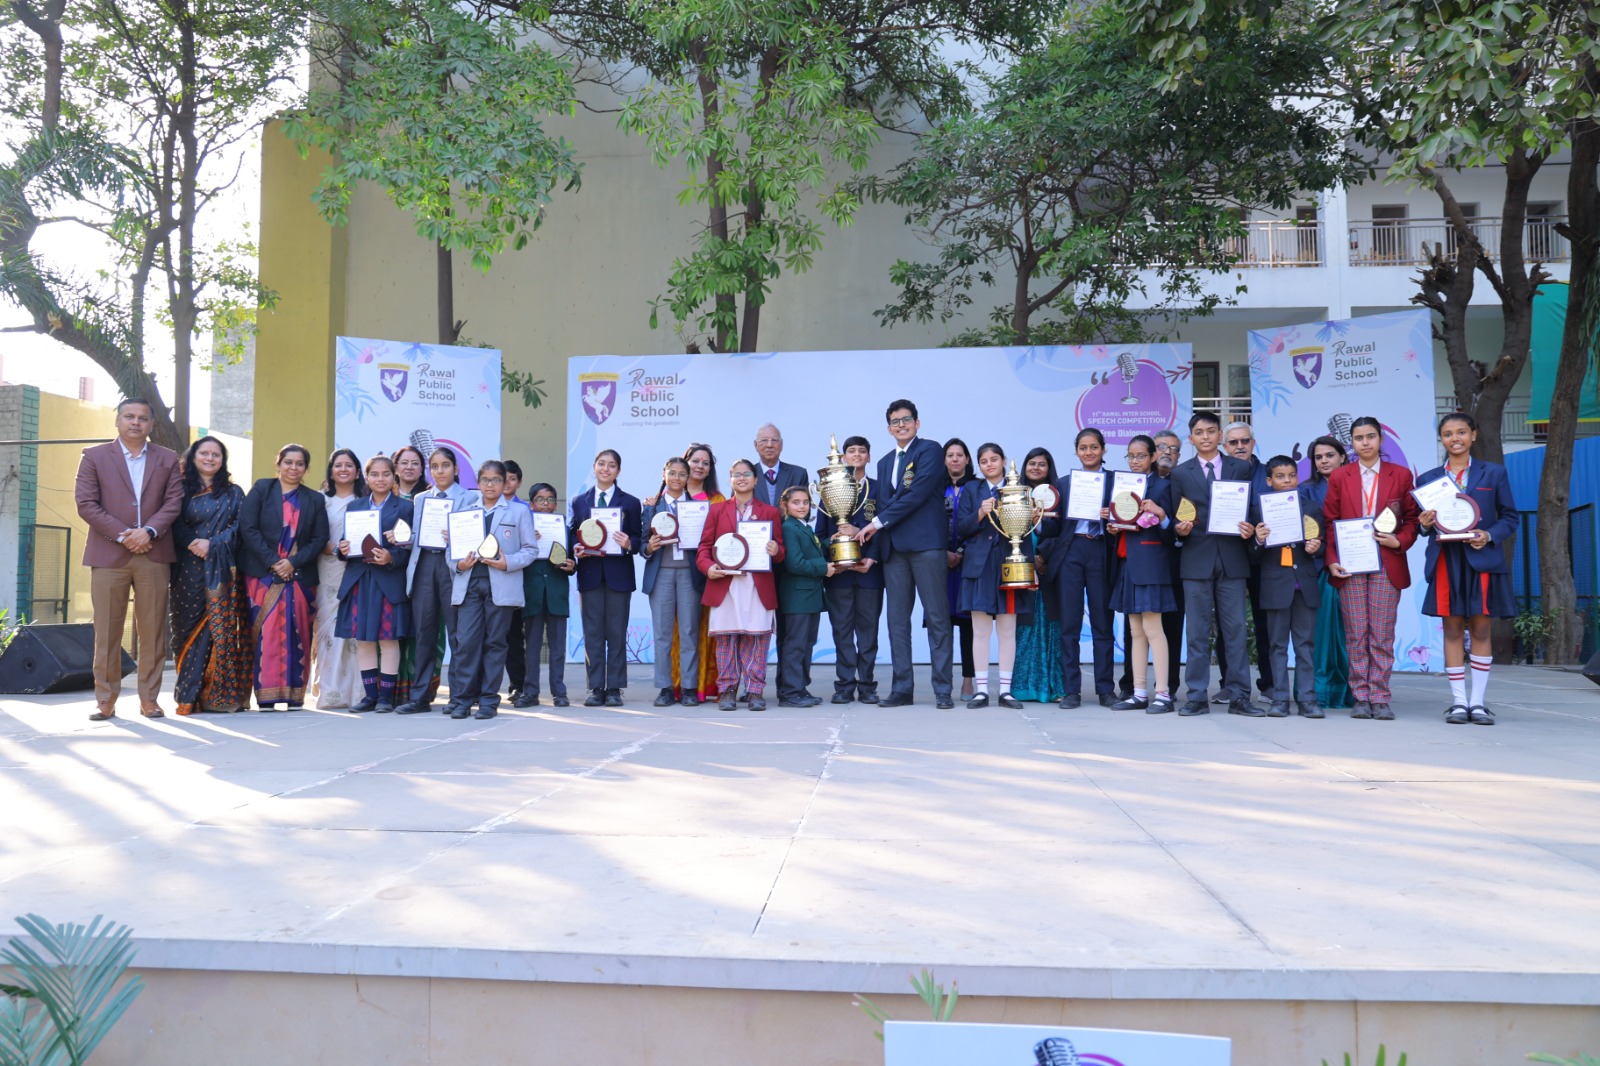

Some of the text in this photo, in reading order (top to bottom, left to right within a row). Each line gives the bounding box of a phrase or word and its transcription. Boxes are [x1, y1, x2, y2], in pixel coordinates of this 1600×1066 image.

[1329, 340, 1376, 356] Rawal
[1334, 356, 1373, 368] Public
[416, 363, 455, 378] Rawal
[1335, 367, 1377, 381] School
[625, 368, 678, 388] Rawal
[418, 379, 452, 390] Public
[418, 390, 456, 401] School
[631, 390, 675, 402] Public
[630, 405, 679, 417] School
[1087, 417, 1116, 425] SPEECH
